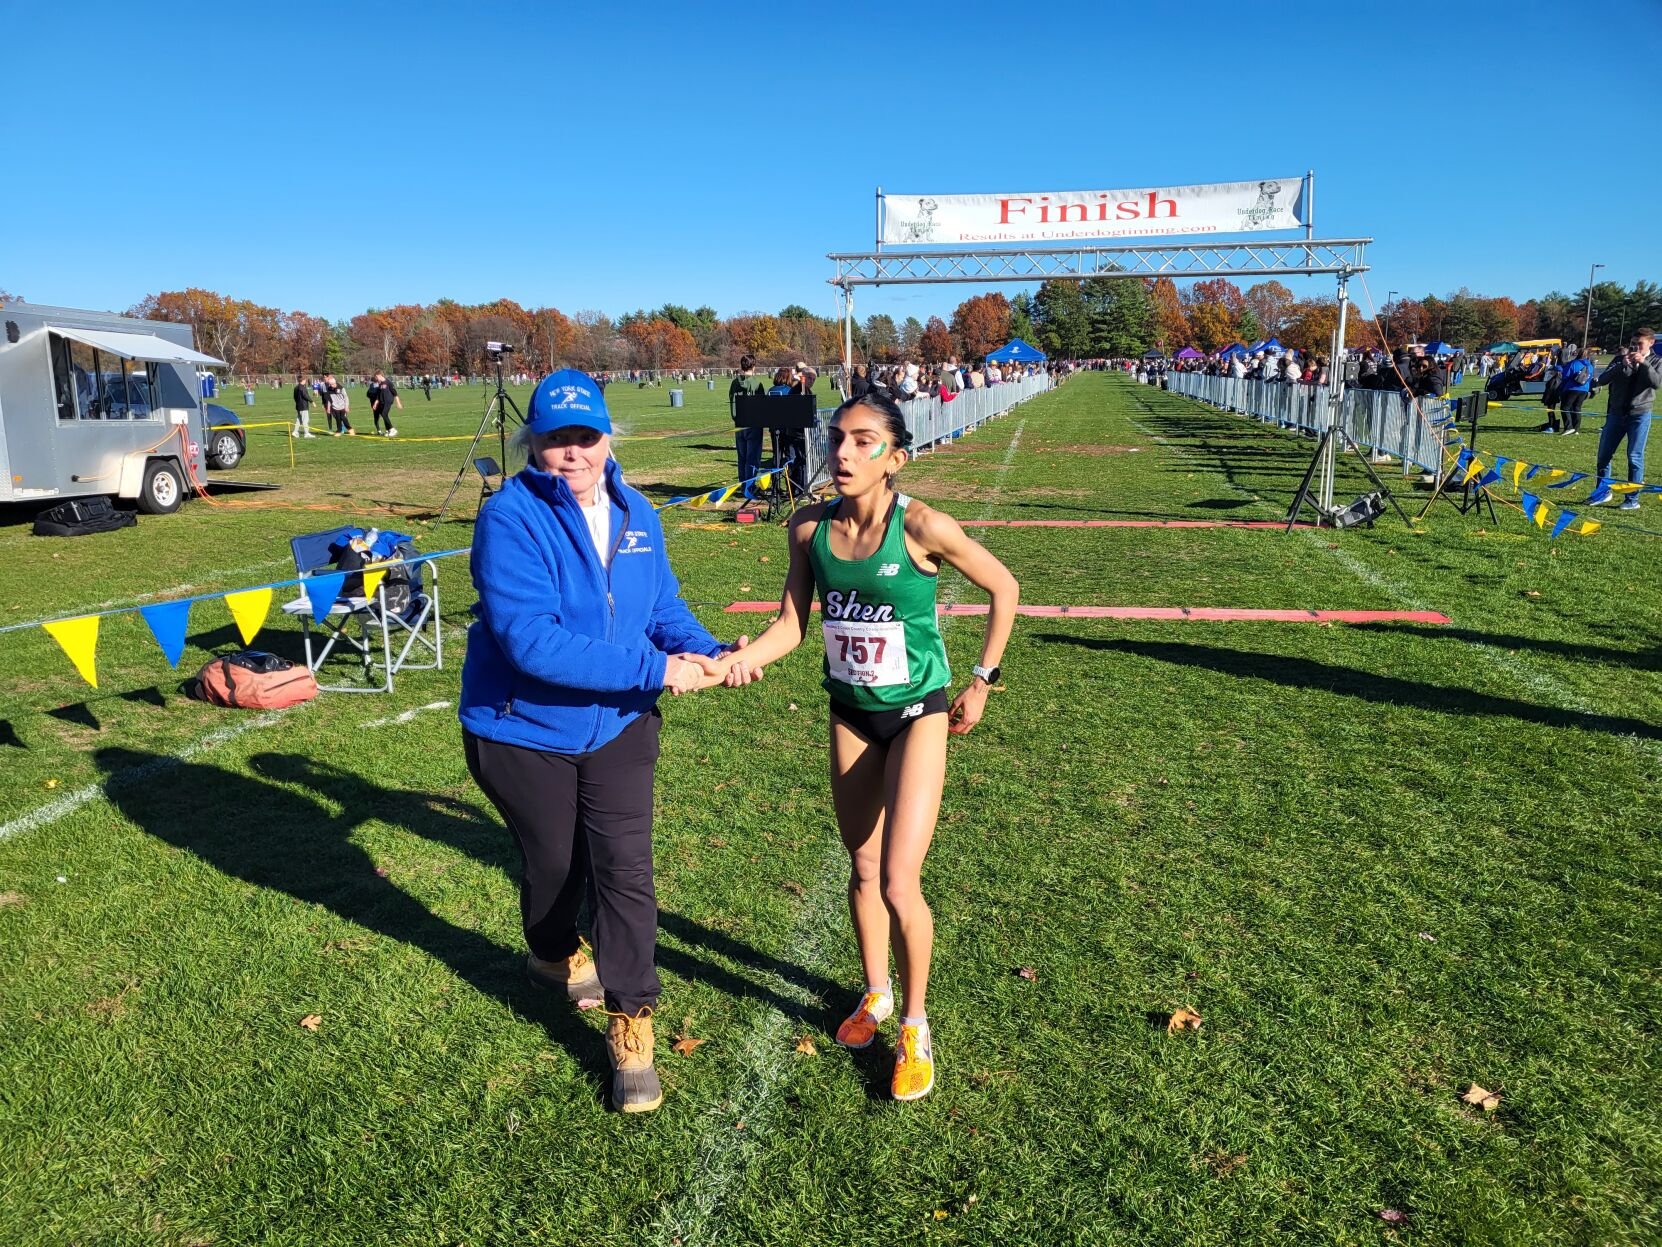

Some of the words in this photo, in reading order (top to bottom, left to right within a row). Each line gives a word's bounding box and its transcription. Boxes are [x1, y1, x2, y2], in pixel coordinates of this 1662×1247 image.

[993, 192, 1181, 224] Finish
[1237, 207, 1266, 215] Underdog
[1268, 206, 1284, 214] Race
[959, 232, 1017, 240] Results
[1041, 225, 1217, 239] Underdogtiming.com
[549, 387, 560, 397] NEW
[577, 386, 591, 398] STATE
[570, 403, 591, 411] OFFICIAL
[826, 590, 894, 622] Shen
[835, 635, 887, 665] 757
